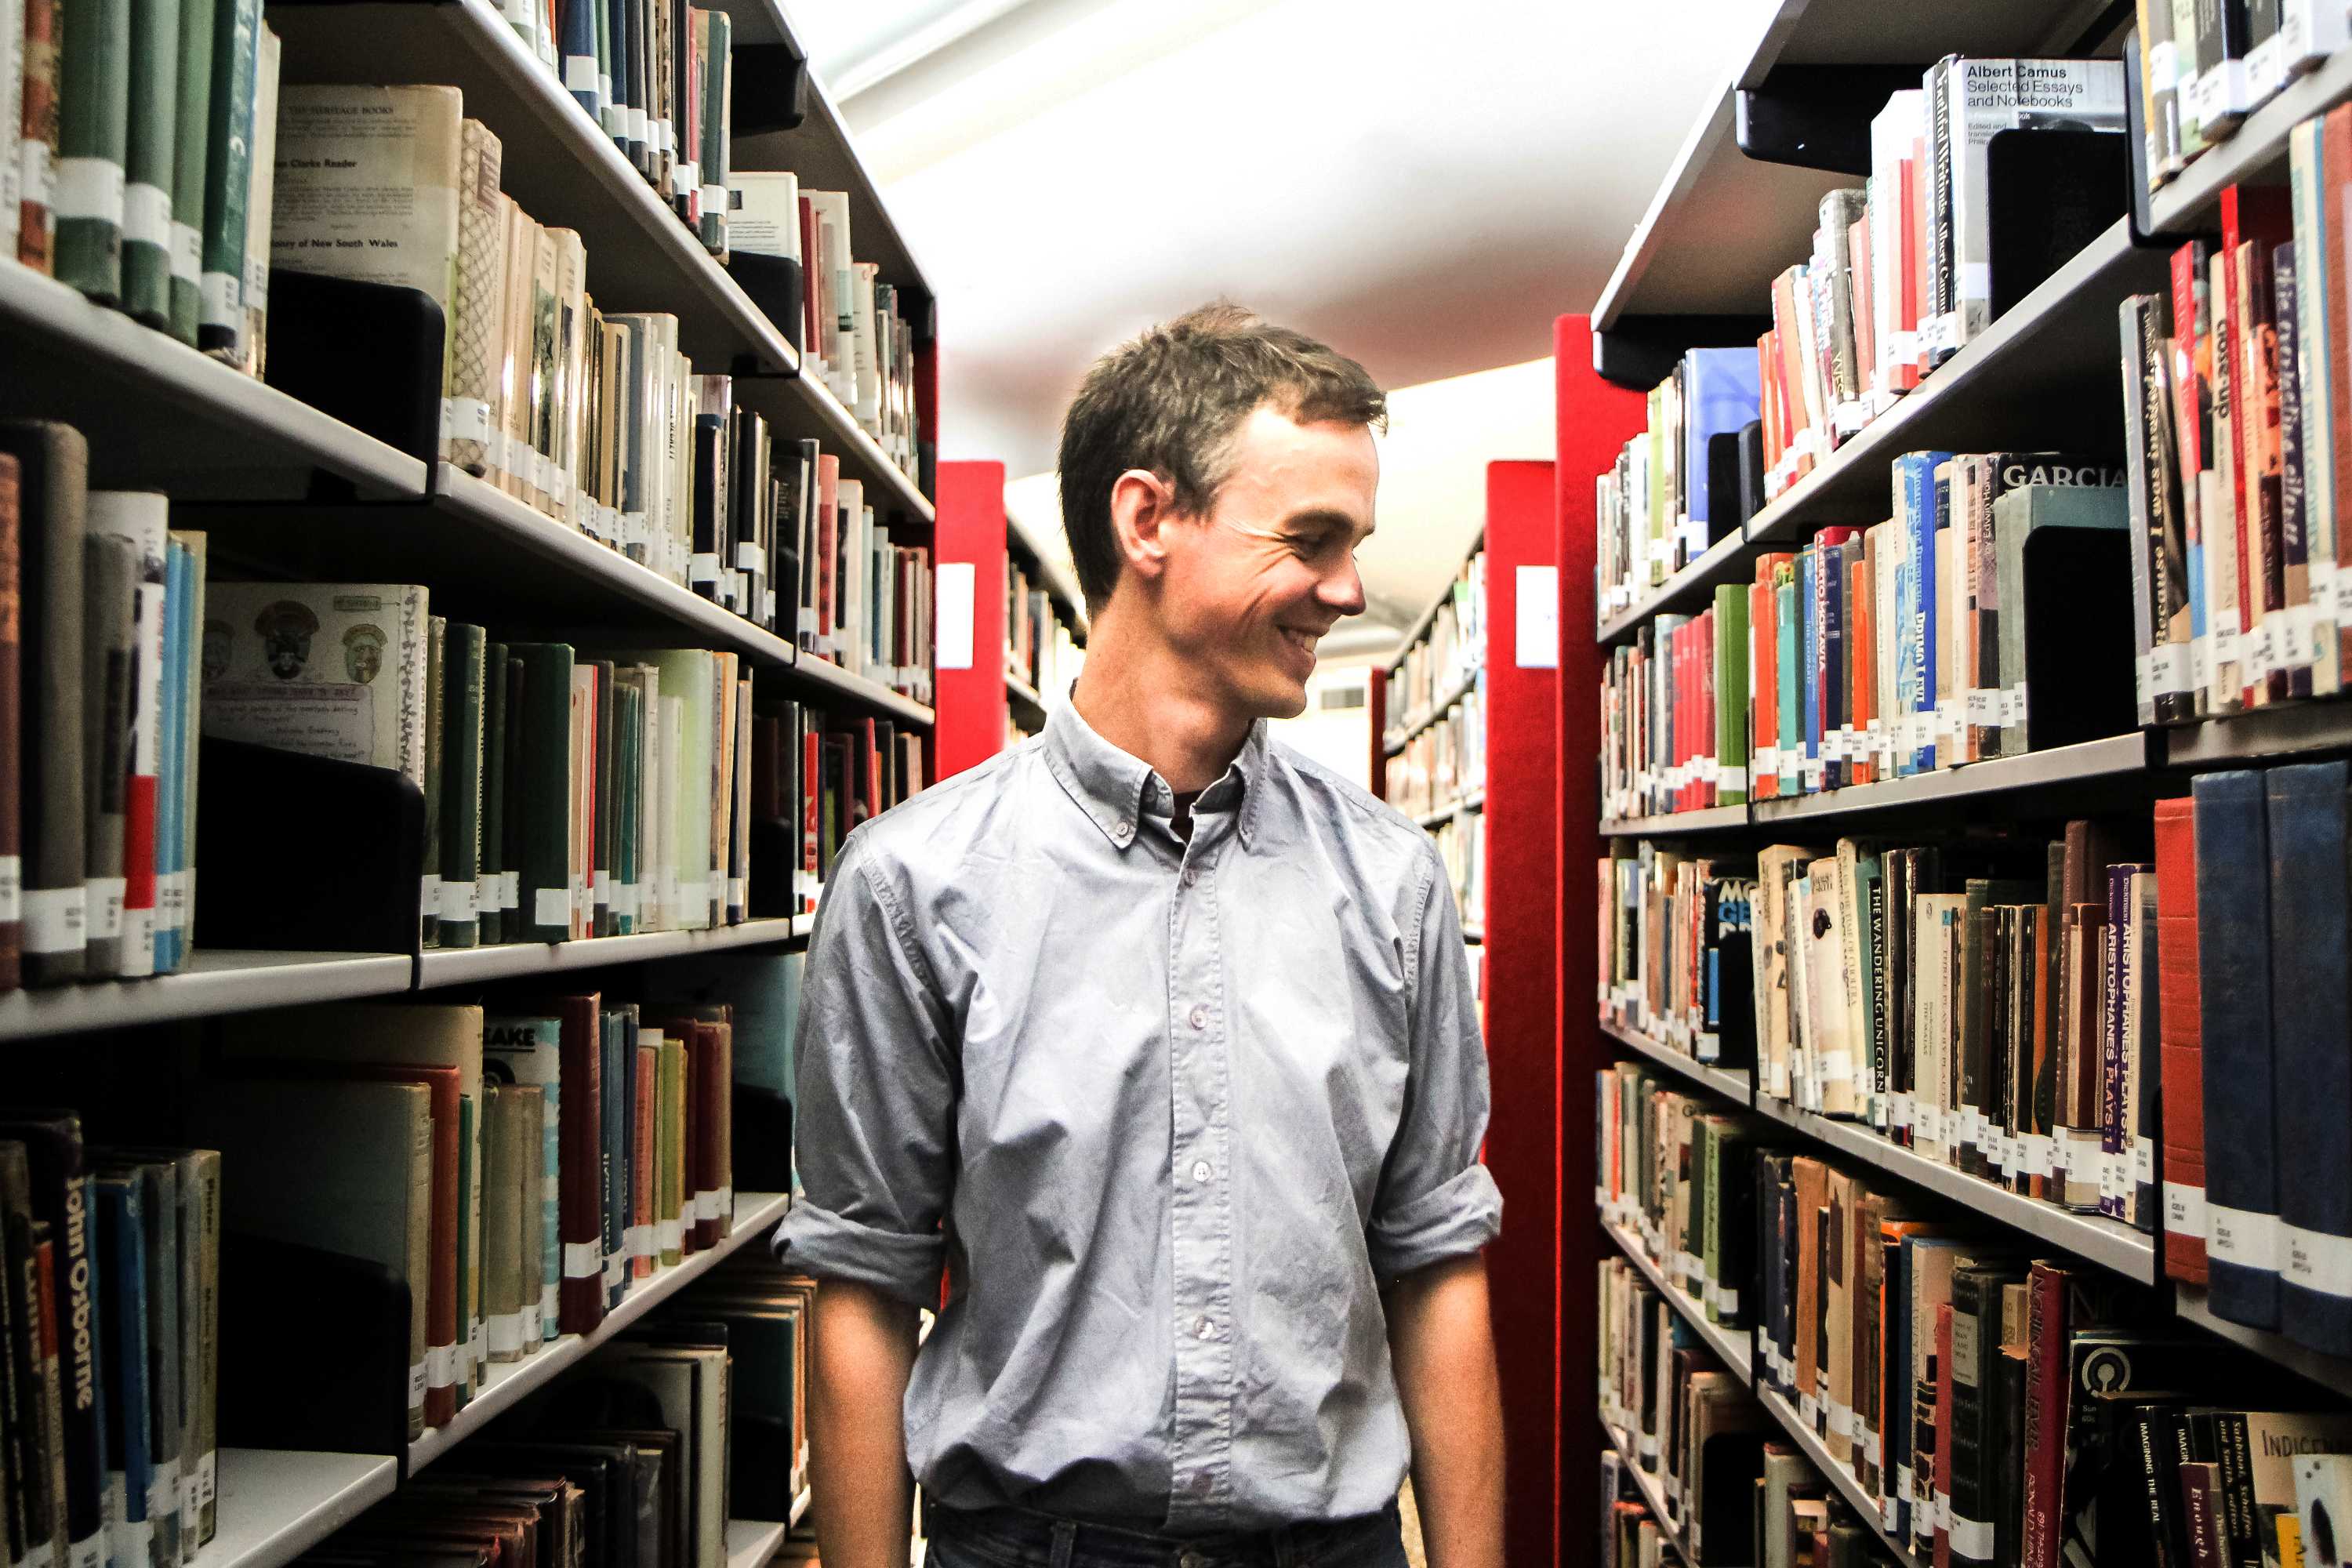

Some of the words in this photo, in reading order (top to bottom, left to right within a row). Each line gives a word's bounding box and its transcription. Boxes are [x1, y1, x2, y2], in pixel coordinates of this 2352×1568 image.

[1967, 66, 2013, 78] Albert
[2016, 67, 2067, 78] Camus
[1967, 80, 2029, 93] Selected
[2033, 81, 2083, 96] Essays
[1967, 96, 1994, 107] and
[1997, 95, 2073, 107] Notebooks
[1935, 68, 1950, 143] Youthful
[325, 158, 358, 168] Reader
[1937, 146, 1951, 216] Writings
[299, 239, 307, 248] of
[311, 239, 332, 248] New
[336, 239, 363, 248] South
[368, 239, 398, 248] Wales
[1939, 220, 1950, 264] Albert
[1817, 533, 1827, 599] ALBERTO
[1817, 600, 1827, 673] MORAVIA
[1871, 886, 1882, 914] THE
[1873, 916, 1884, 1014] WANDERING
[2105, 923, 2118, 1060] ARISTOPHANES
[2121, 923, 2133, 1063] ARISTOPHANES
[1875, 1017, 1885, 1091] UNICORN
[69, 1257, 94, 1411] Osborne
[2031, 1274, 2045, 1392] NIGHTINGALE
[2139, 1422, 2154, 1475] IMAGINING
[2219, 1420, 2229, 1443] and
[2026, 1472, 2037, 1532] RONALD
[2147, 1479, 2156, 1497] THE
[2150, 1500, 2161, 1524] REAL
[2191, 1487, 2209, 1557] Enough
